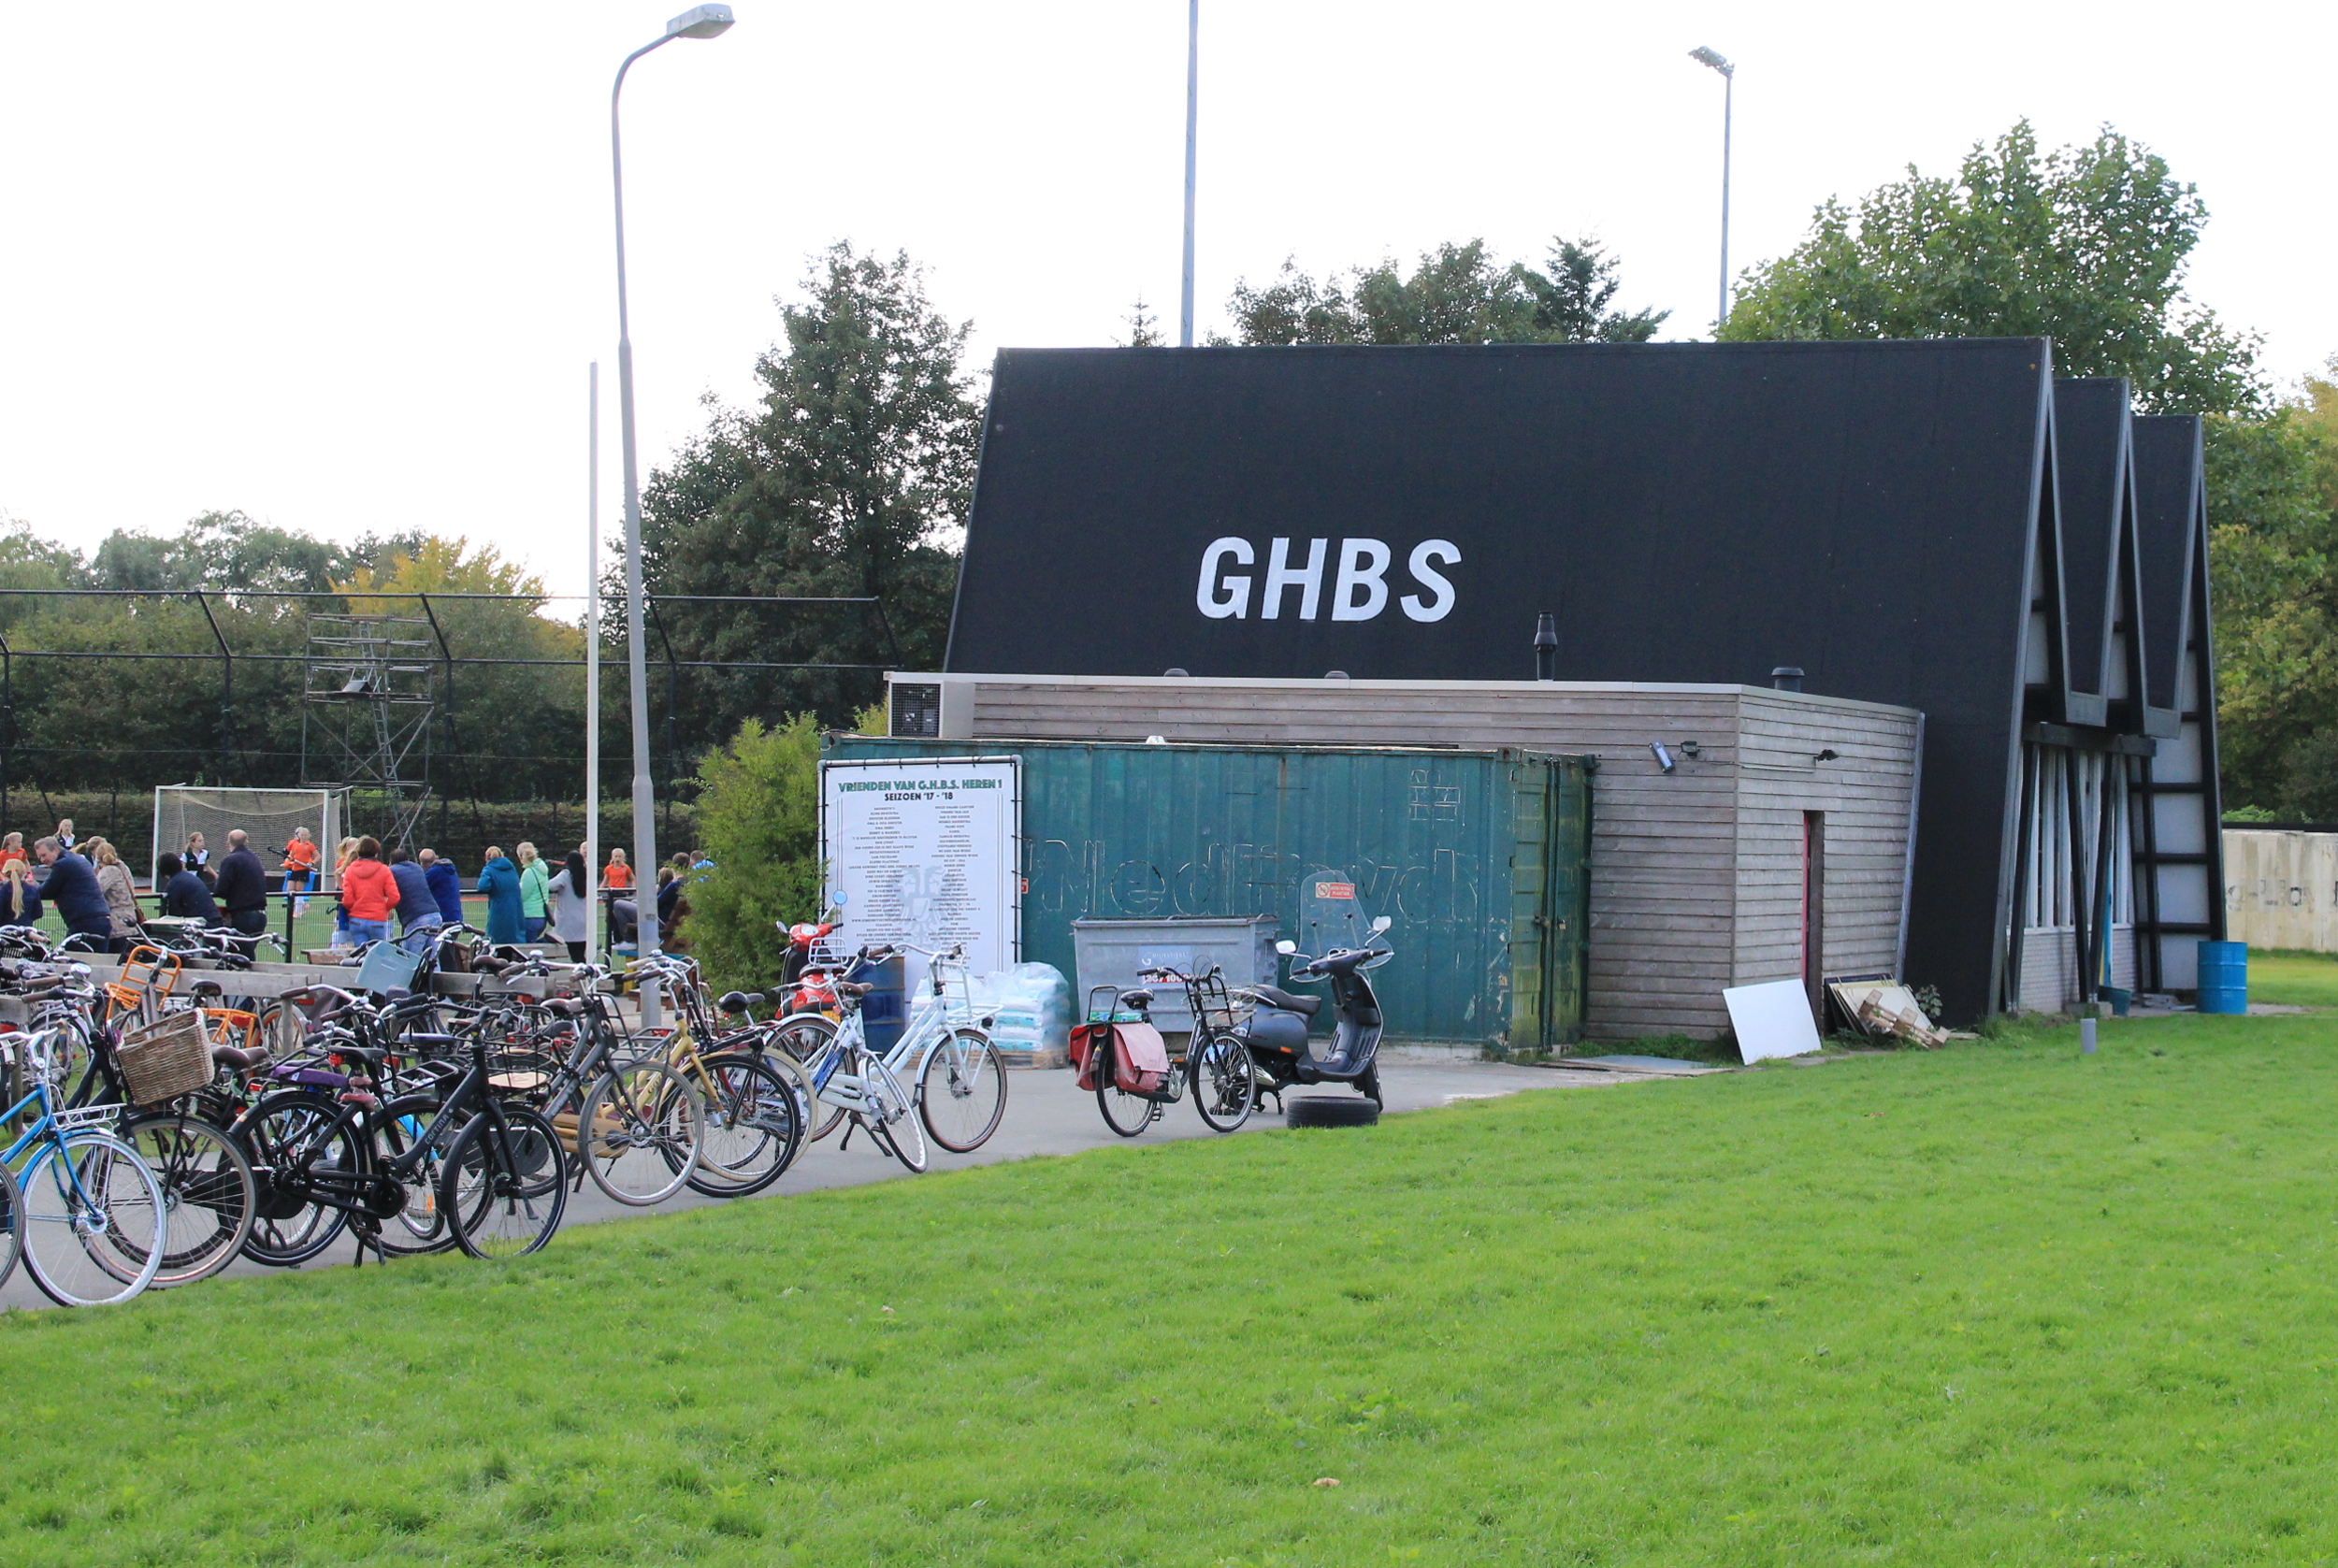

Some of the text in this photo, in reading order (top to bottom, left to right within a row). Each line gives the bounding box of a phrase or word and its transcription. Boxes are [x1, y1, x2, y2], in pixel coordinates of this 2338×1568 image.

[1196, 537, 1462, 623] GHBS
[838, 779, 1003, 792] VRIENDEN VAN G.H.B.S. HEREN 1
[885, 793, 921, 801] SEIZOEN
